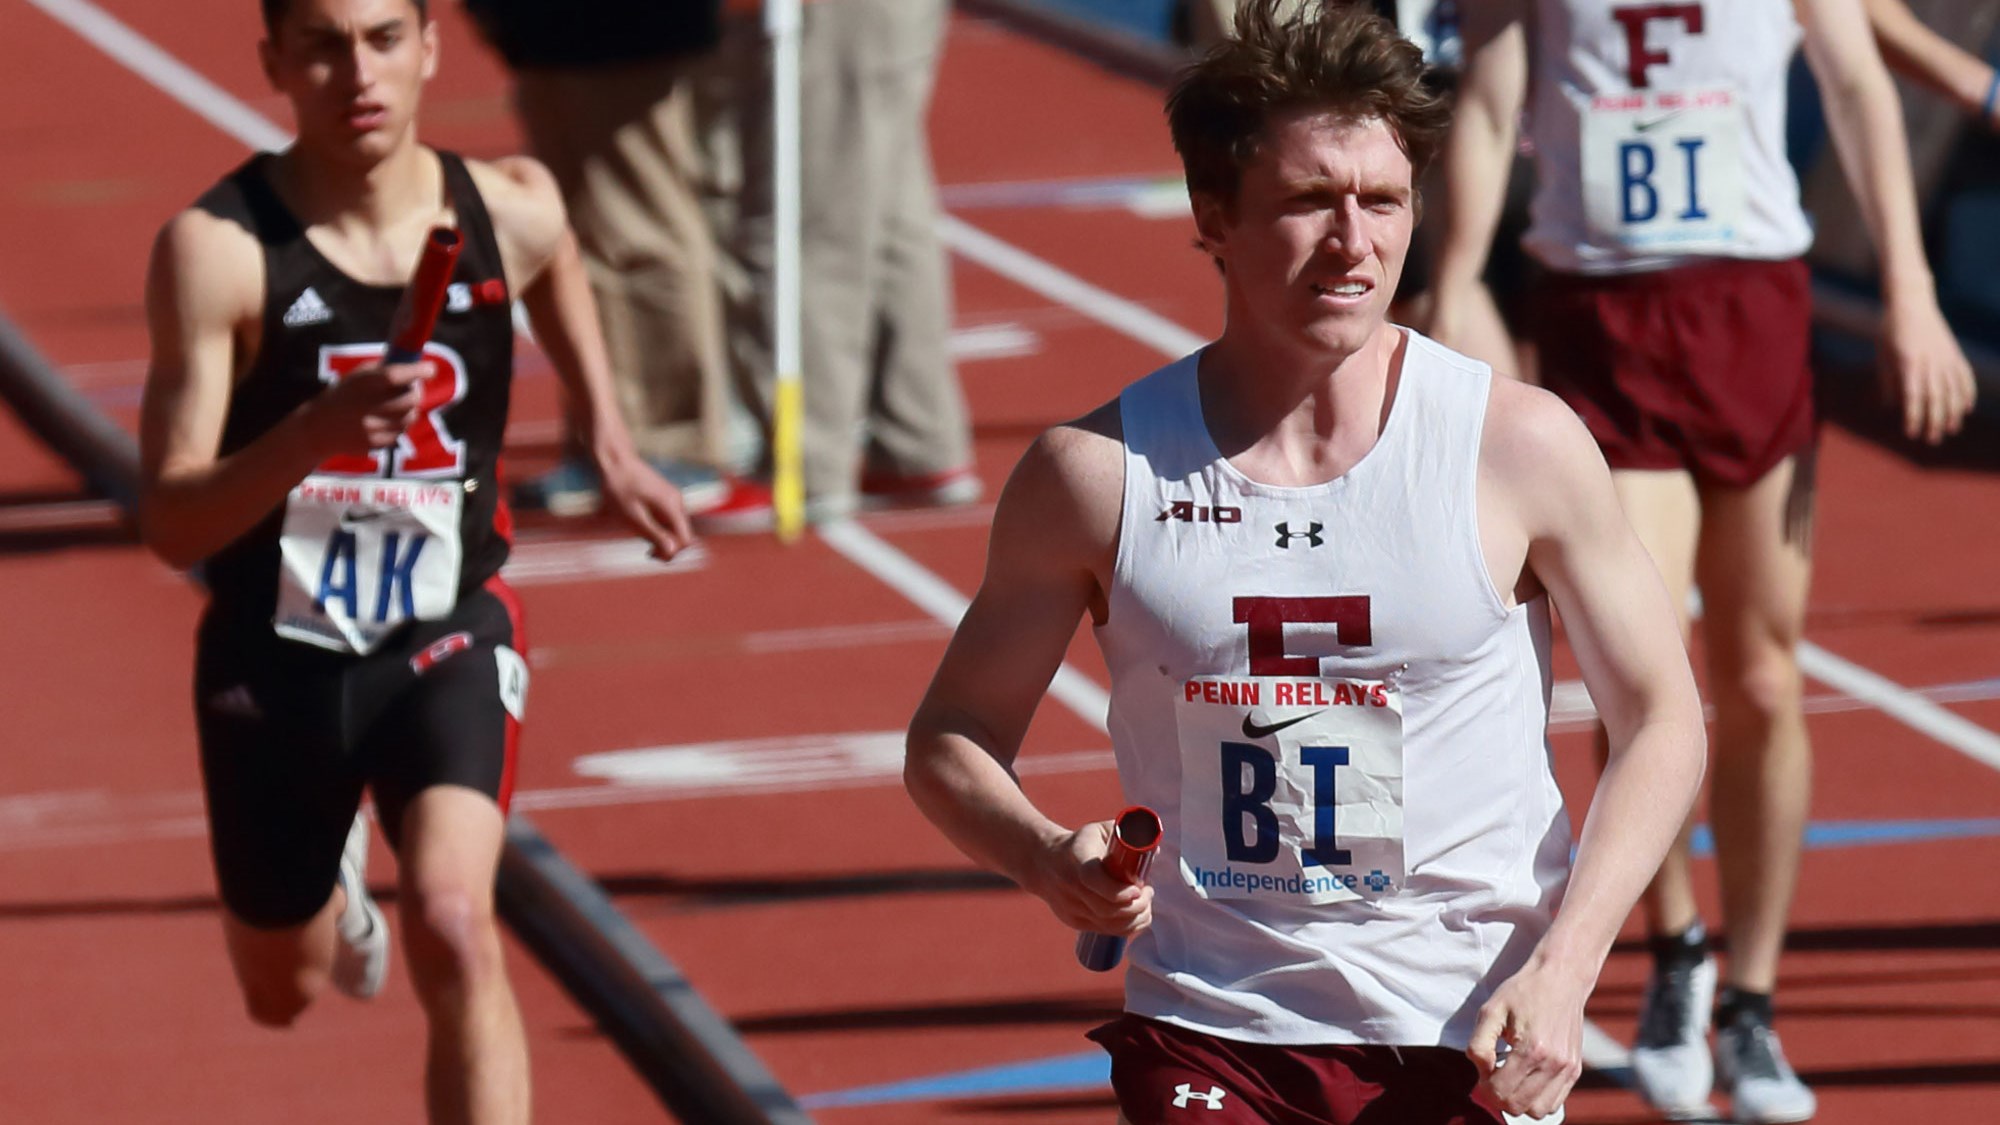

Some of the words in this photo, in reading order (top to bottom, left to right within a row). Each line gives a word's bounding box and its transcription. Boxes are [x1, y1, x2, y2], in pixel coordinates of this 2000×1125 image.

[1612, 5, 1703, 87] F
[1619, 136, 1708, 223] BI
[314, 528, 427, 622] AK
[1232, 595, 1372, 676] F
[1184, 680, 1260, 707] PENN
[1275, 681, 1388, 708] RELAYS
[1220, 741, 1352, 864] BI
[1195, 866, 1358, 894] Independence
